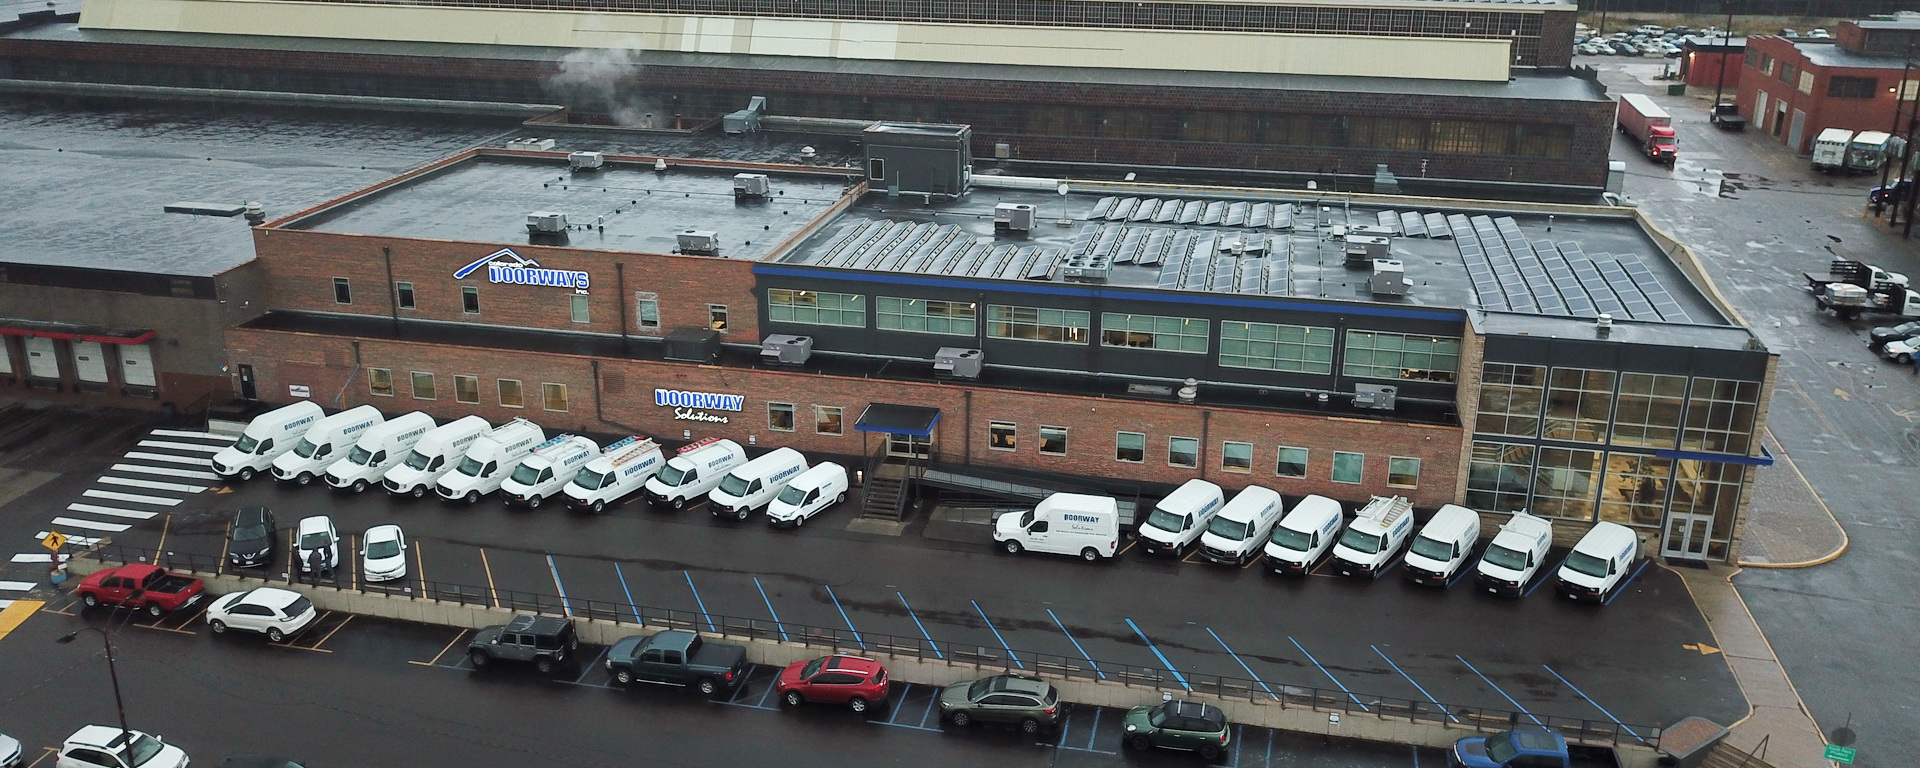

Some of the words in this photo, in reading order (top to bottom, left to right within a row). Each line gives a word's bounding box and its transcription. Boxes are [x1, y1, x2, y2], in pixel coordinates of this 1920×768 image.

[489, 266, 589, 289] DOORWAYS
[655, 389, 744, 411] DOORWAY
[284, 416, 314, 431] DOORWAY
[674, 407, 729, 424] Solutions
[343, 420, 374, 435] DOORWAY
[397, 427, 426, 442] DOORWAY
[452, 432, 481, 448] DOORWAY
[624, 456, 656, 476] DOORWAY
[770, 464, 800, 484] DOORWAY
[1064, 513, 1100, 523] DOORWAY
